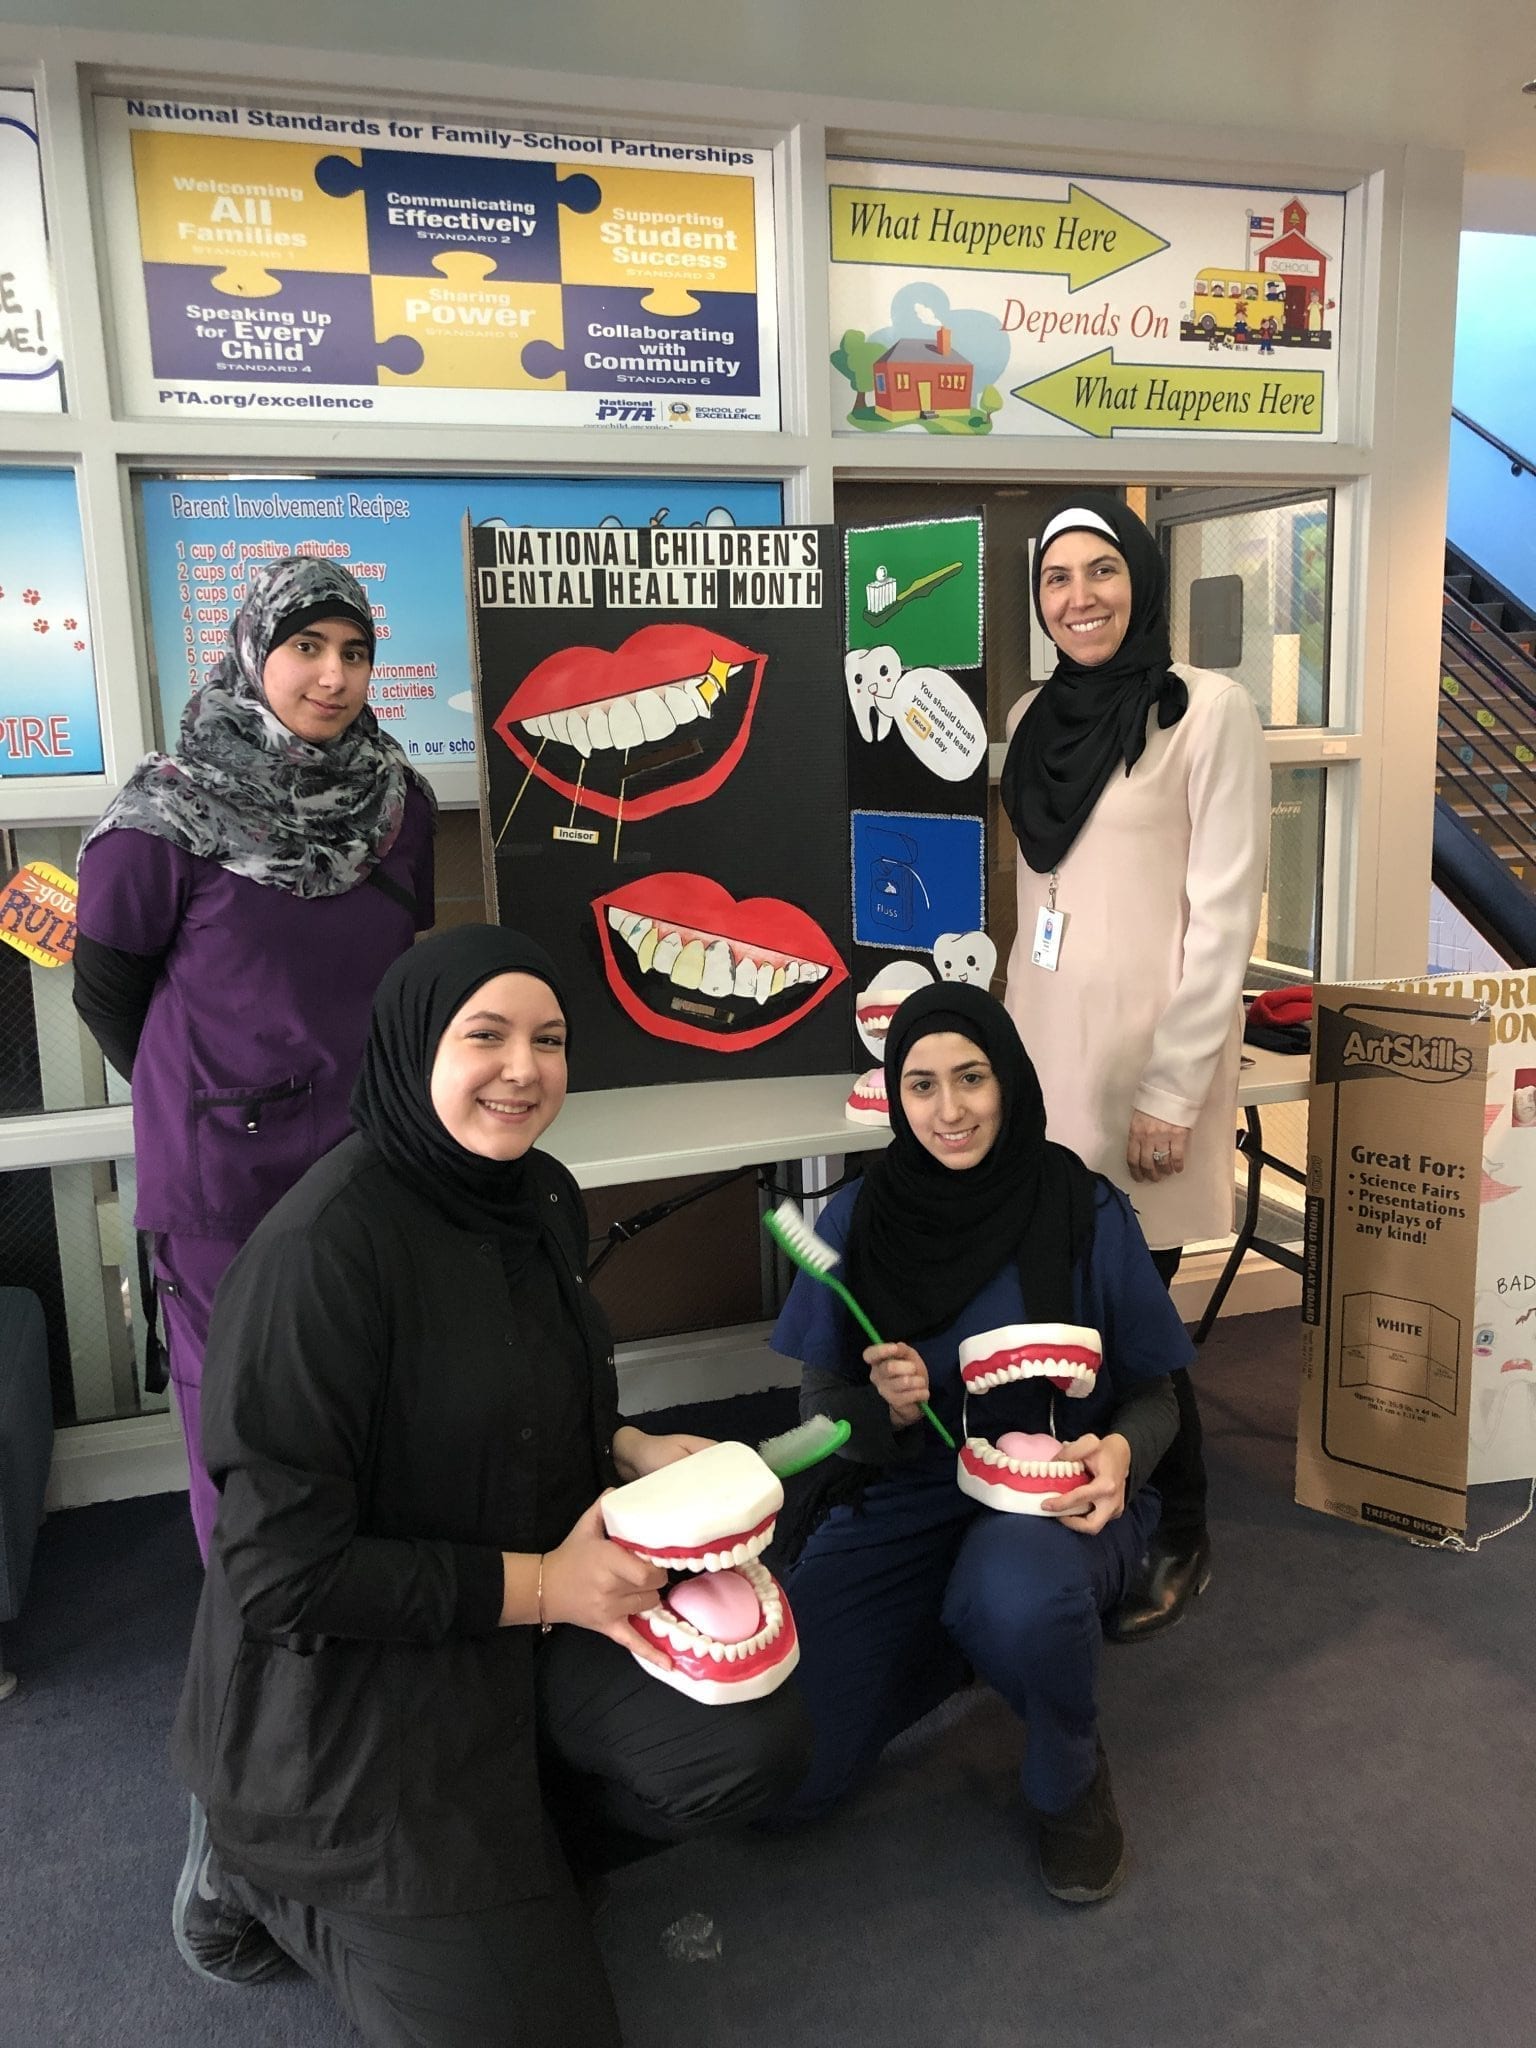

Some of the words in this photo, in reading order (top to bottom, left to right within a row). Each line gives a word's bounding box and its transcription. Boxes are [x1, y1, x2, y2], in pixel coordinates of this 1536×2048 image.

[127, 100, 239, 124] National
[247, 109, 380, 136] Standards
[389, 122, 423, 139] for
[432, 125, 603, 153] Family-School
[611, 139, 754, 166] Partnerships
[173, 176, 304, 202] Welcoming
[210, 196, 272, 226] All
[387, 192, 536, 215] Communicating
[388, 207, 537, 237] Effectively
[612, 207, 724, 229] Supporting
[850, 202, 920, 240] What
[928, 208, 1045, 255] Happens
[1053, 216, 1116, 253] Here
[177, 222, 307, 248] Families
[417, 230, 498, 244] STANDARD
[500, 235, 512, 244] 2
[600, 222, 738, 251] Student
[612, 246, 727, 269] Success
[1270, 260, 1313, 274] SCHOOL
[626, 268, 702, 280] STANDARD
[706, 272, 716, 280] 3
[428, 287, 511, 306] Sharing
[186, 304, 295, 325] Speaking
[302, 310, 332, 326] Up
[405, 298, 536, 327] Power
[999, 299, 1121, 343] Depends
[1130, 304, 1169, 339] On
[196, 325, 227, 338] for
[234, 321, 325, 346] Every
[587, 323, 735, 345] Collaborating
[221, 340, 304, 361] Child
[639, 344, 686, 356] with
[216, 362, 298, 373] STANDARD
[301, 365, 312, 373] 4
[584, 352, 741, 377] Community
[616, 374, 697, 385] STANDARD
[700, 377, 711, 385] 6
[159, 390, 374, 409] PTA.org/excellence
[599, 399, 653, 407] National
[1075, 376, 1138, 410] What
[1145, 379, 1251, 421] Happens
[1257, 383, 1315, 415] Here
[595, 406, 656, 422] PTA
[695, 406, 733, 414] SCHOOL
[172, 494, 229, 519] Parent
[234, 494, 344, 519] Involvement
[349, 494, 410, 523] Recipe:
[176, 541, 185, 559] 1
[191, 544, 216, 562] cup
[221, 540, 235, 559] of
[240, 540, 290, 562] positive
[296, 540, 351, 557] attitudes
[498, 531, 638, 566] NATIONAL
[654, 532, 817, 566] CHILDREN'S
[177, 562, 188, 580] 2
[193, 566, 225, 583] cups
[231, 562, 244, 579] of
[180, 585, 190, 602] 3
[196, 587, 227, 605] cups
[232, 584, 246, 601] of
[481, 570, 592, 605] DENTAL
[609, 571, 717, 606] HEALTH
[732, 572, 821, 605] MONTH
[183, 605, 192, 622] 4
[197, 608, 229, 626] cups
[185, 626, 194, 644] 3
[187, 647, 196, 664] 5
[189, 668, 198, 685] 2
[382, 682, 435, 699] activities
[920, 681, 933, 699] You
[933, 697, 957, 723] should
[955, 719, 976, 744] brush
[911, 695, 929, 713] your
[928, 710, 946, 731] teeth
[945, 730, 954, 740] at
[953, 736, 970, 757] least
[928, 731, 935, 739] a
[408, 739, 419, 753] in
[424, 741, 443, 753] our
[449, 738, 476, 752] scho
[558, 829, 594, 840] Incisor
[1343, 1030, 1472, 1074] ArtSkills
[1351, 1145, 1411, 1171] Great
[1420, 1155, 1465, 1179] For:
[1360, 1172, 1416, 1193] Science
[1422, 1182, 1460, 1200] Fairs
[1359, 1189, 1466, 1218] Presentations
[1309, 1200, 1319, 1241] TRIFOLD
[1358, 1205, 1420, 1228] Displays
[1425, 1217, 1442, 1231] of
[1356, 1223, 1382, 1239] any
[1388, 1225, 1427, 1245] kind!
[1307, 1244, 1318, 1286] DISPLAY
[1496, 1275, 1536, 1295] BAD
[1306, 1288, 1316, 1322] BOARD
[1376, 1317, 1423, 1337] WHITE
[1365, 1506, 1410, 1526] TRIFOLD
